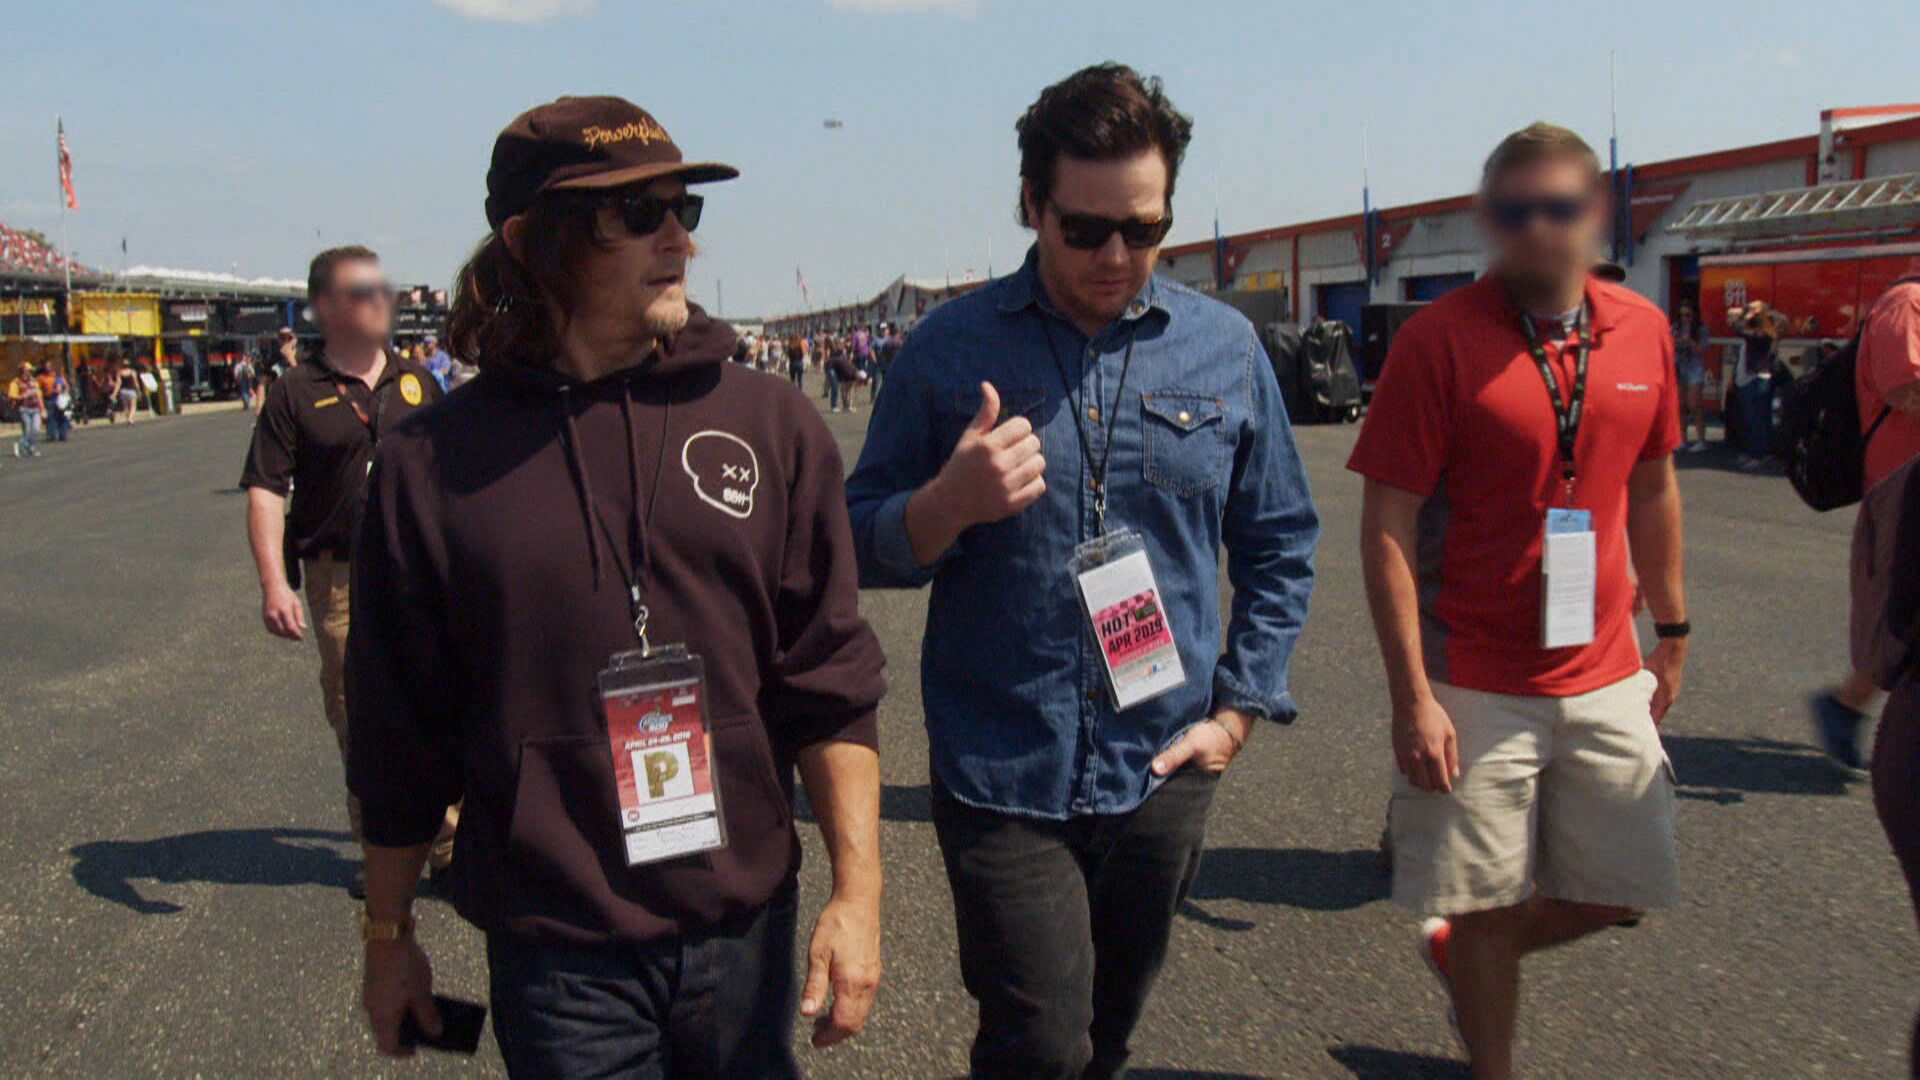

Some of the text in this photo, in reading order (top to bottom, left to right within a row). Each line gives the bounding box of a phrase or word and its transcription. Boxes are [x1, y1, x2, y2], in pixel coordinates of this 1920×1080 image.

[1101, 610, 1132, 639] HOT
[1109, 630, 1134, 656] APR
[1134, 617, 1164, 643] 2019
[644, 750, 680, 800] P
